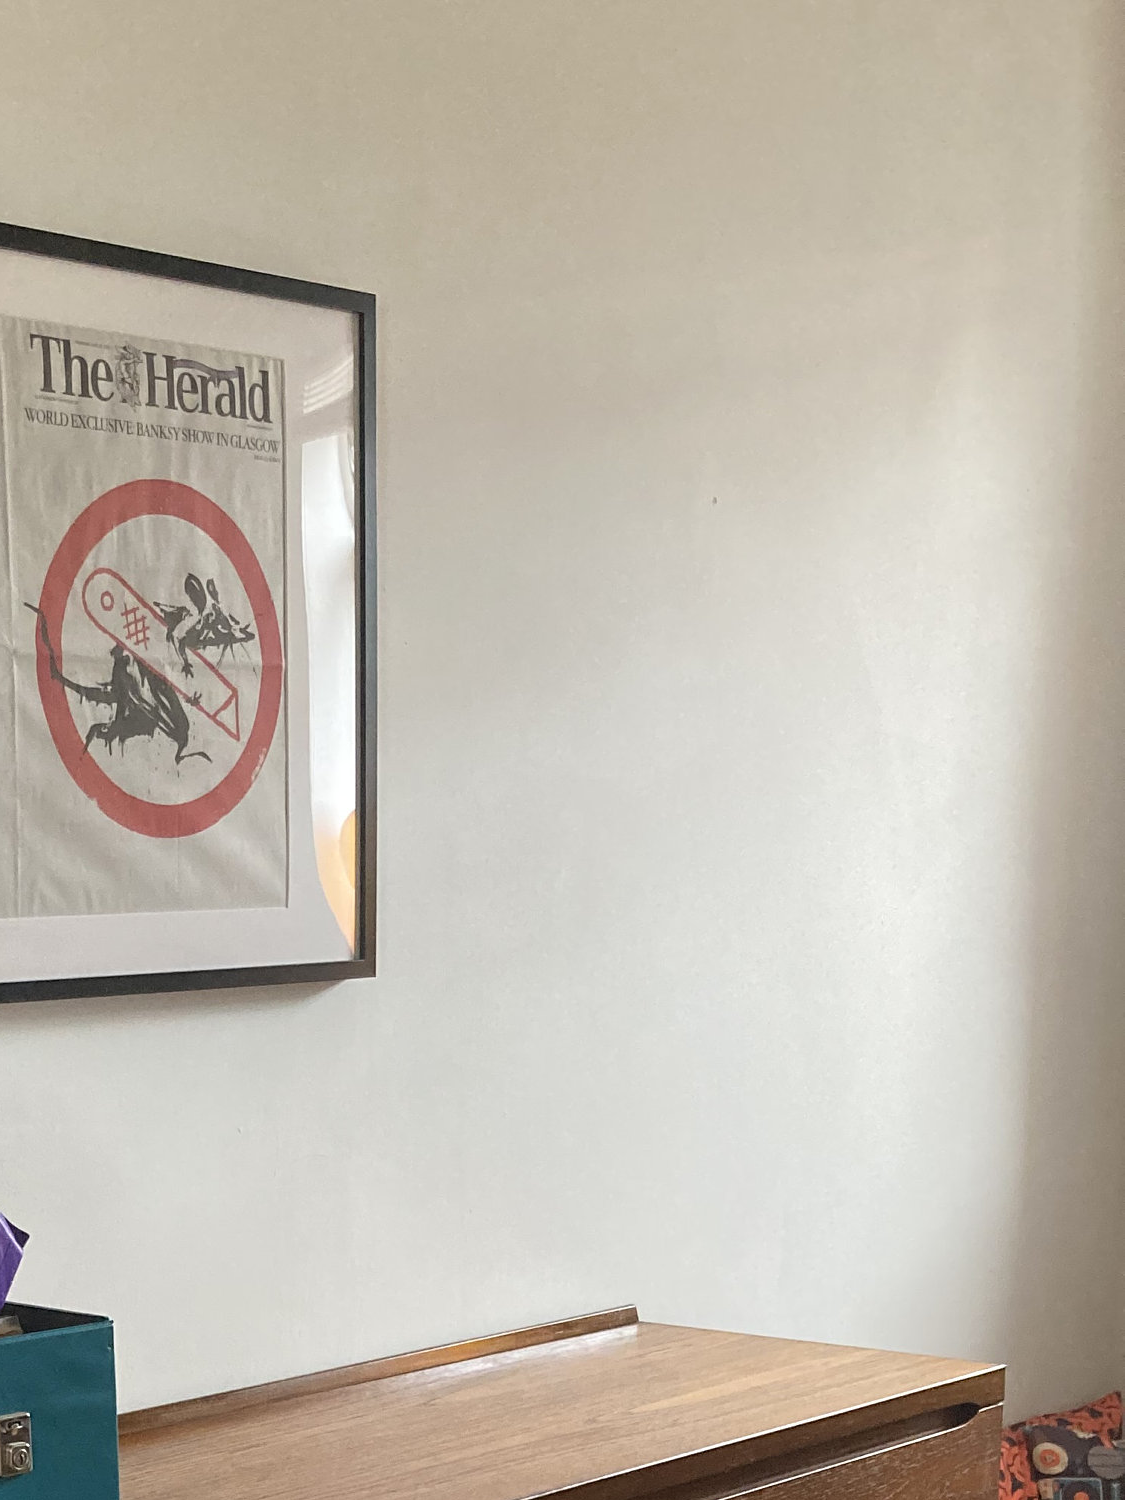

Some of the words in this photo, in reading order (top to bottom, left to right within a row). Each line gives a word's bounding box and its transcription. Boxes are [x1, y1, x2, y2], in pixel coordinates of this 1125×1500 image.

[29, 333, 115, 402] The
[142, 350, 274, 424] Herald
[24, 406, 70, 428] WORLD
[71, 413, 135, 436] EXCLUSIVE
[136, 421, 181, 442] BANKSY
[181, 427, 217, 447] SHOW
[216, 432, 229, 448] IN
[230, 434, 281, 454] GLASGOW
